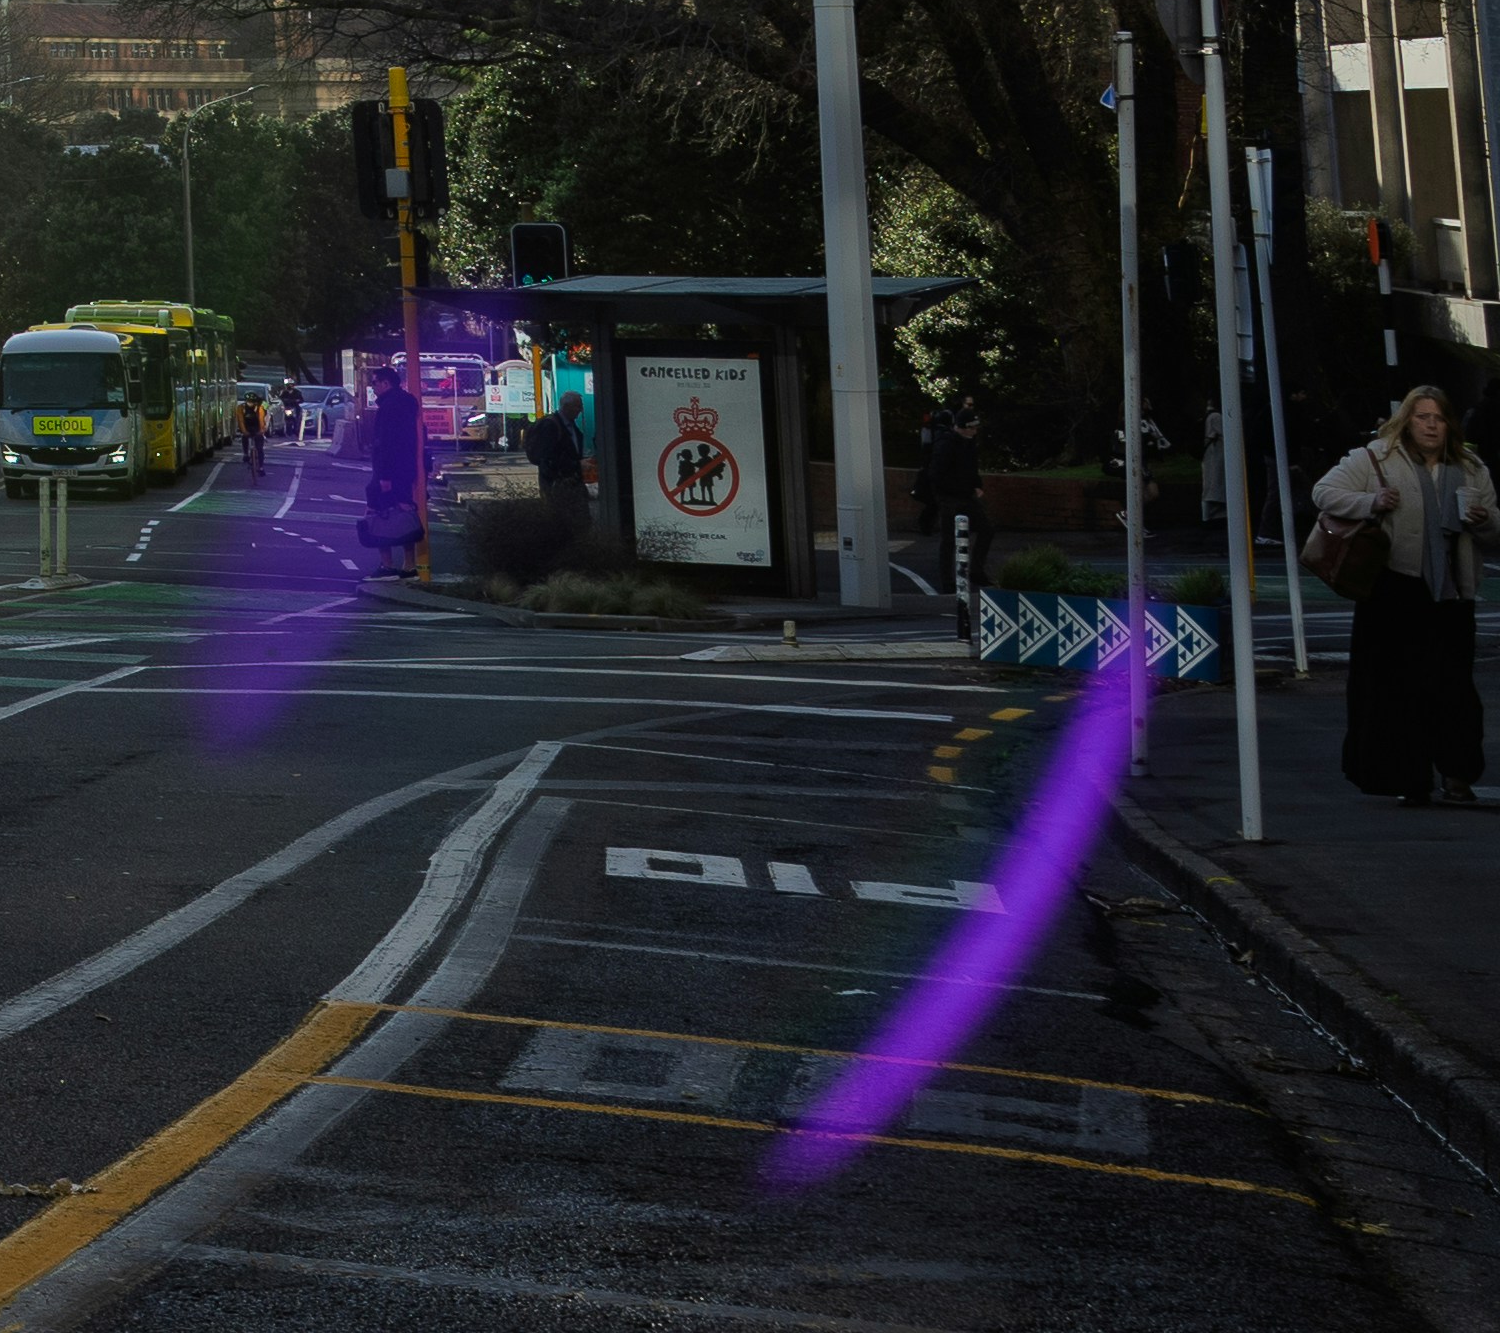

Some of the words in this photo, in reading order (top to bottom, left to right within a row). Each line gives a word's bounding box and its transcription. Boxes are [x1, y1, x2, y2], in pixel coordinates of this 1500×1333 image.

[640, 366, 710, 380] CANCELLED
[715, 369, 747, 381] KIDS
[38, 420, 87, 431] SCHOOL
